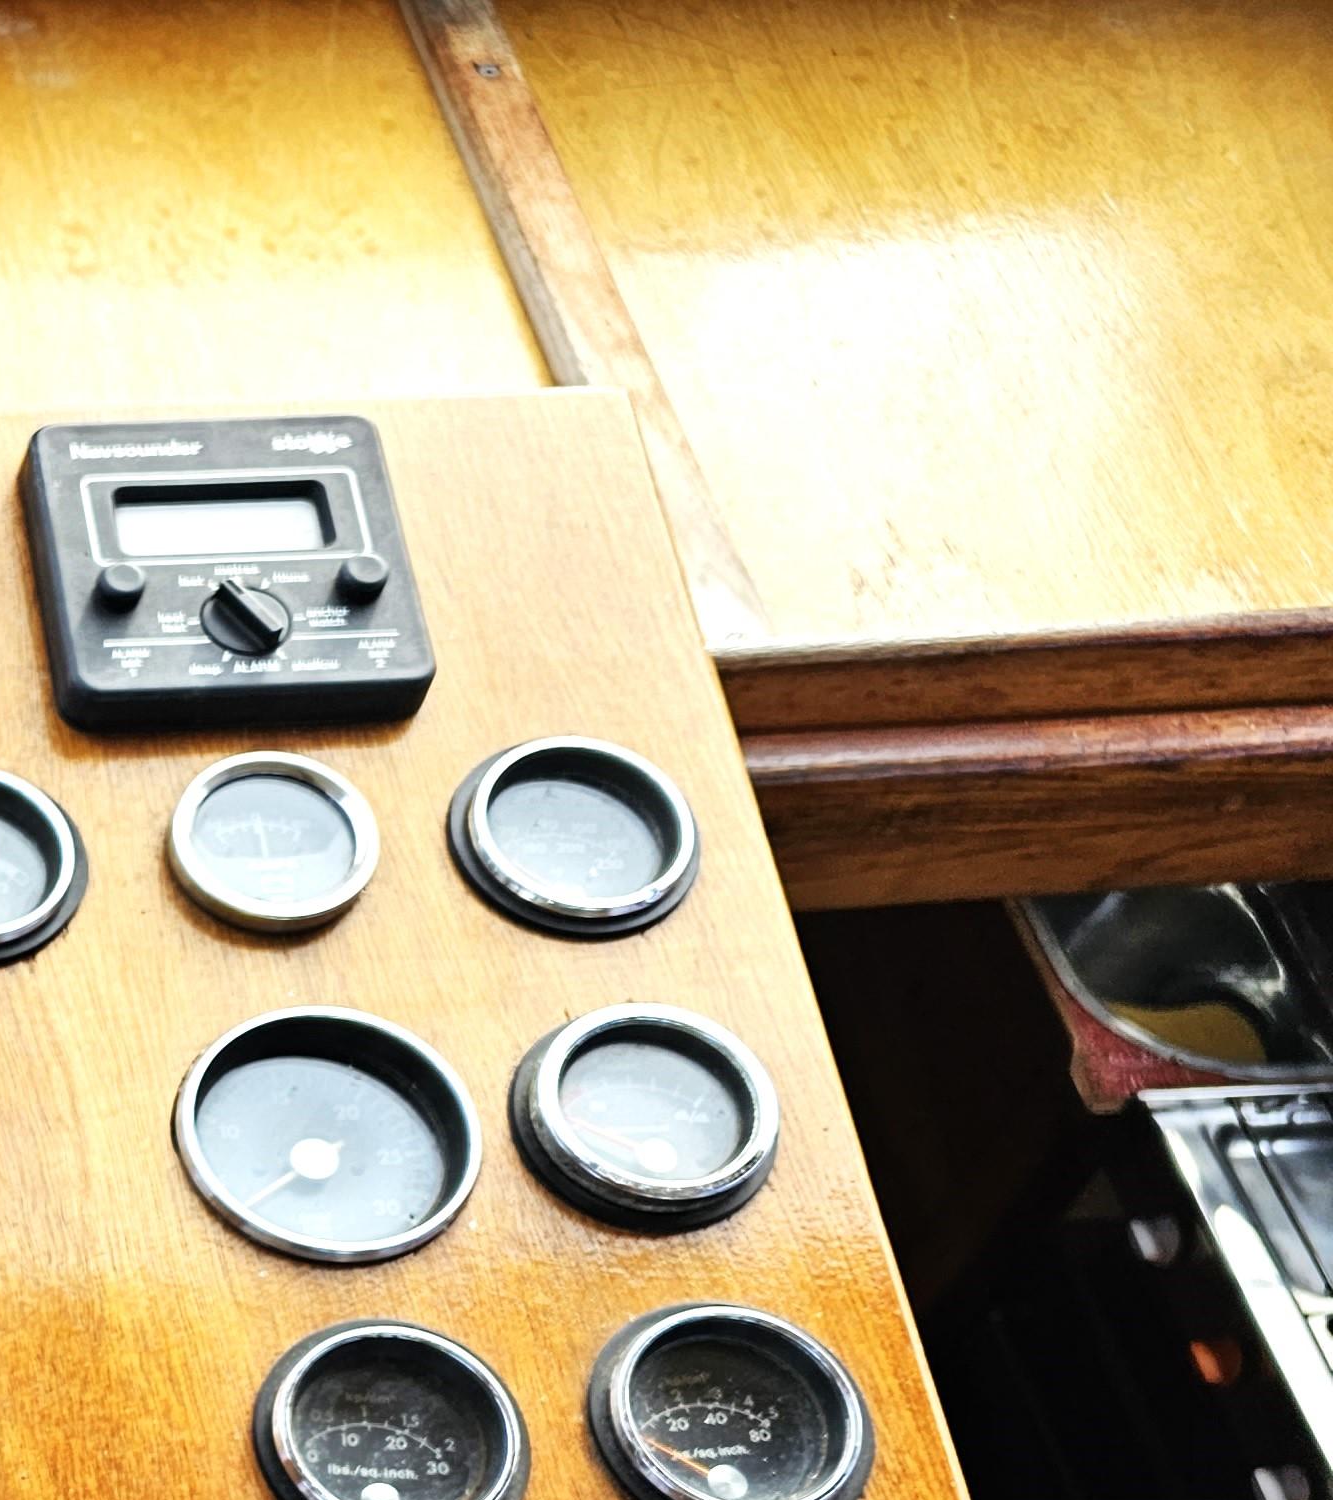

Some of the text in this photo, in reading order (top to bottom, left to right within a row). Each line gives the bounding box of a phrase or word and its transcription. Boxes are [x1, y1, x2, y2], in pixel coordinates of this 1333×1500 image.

[341, 1433, 360, 1447] 10
[385, 1437, 408, 1451] 20
[426, 1461, 450, 1475] 30
